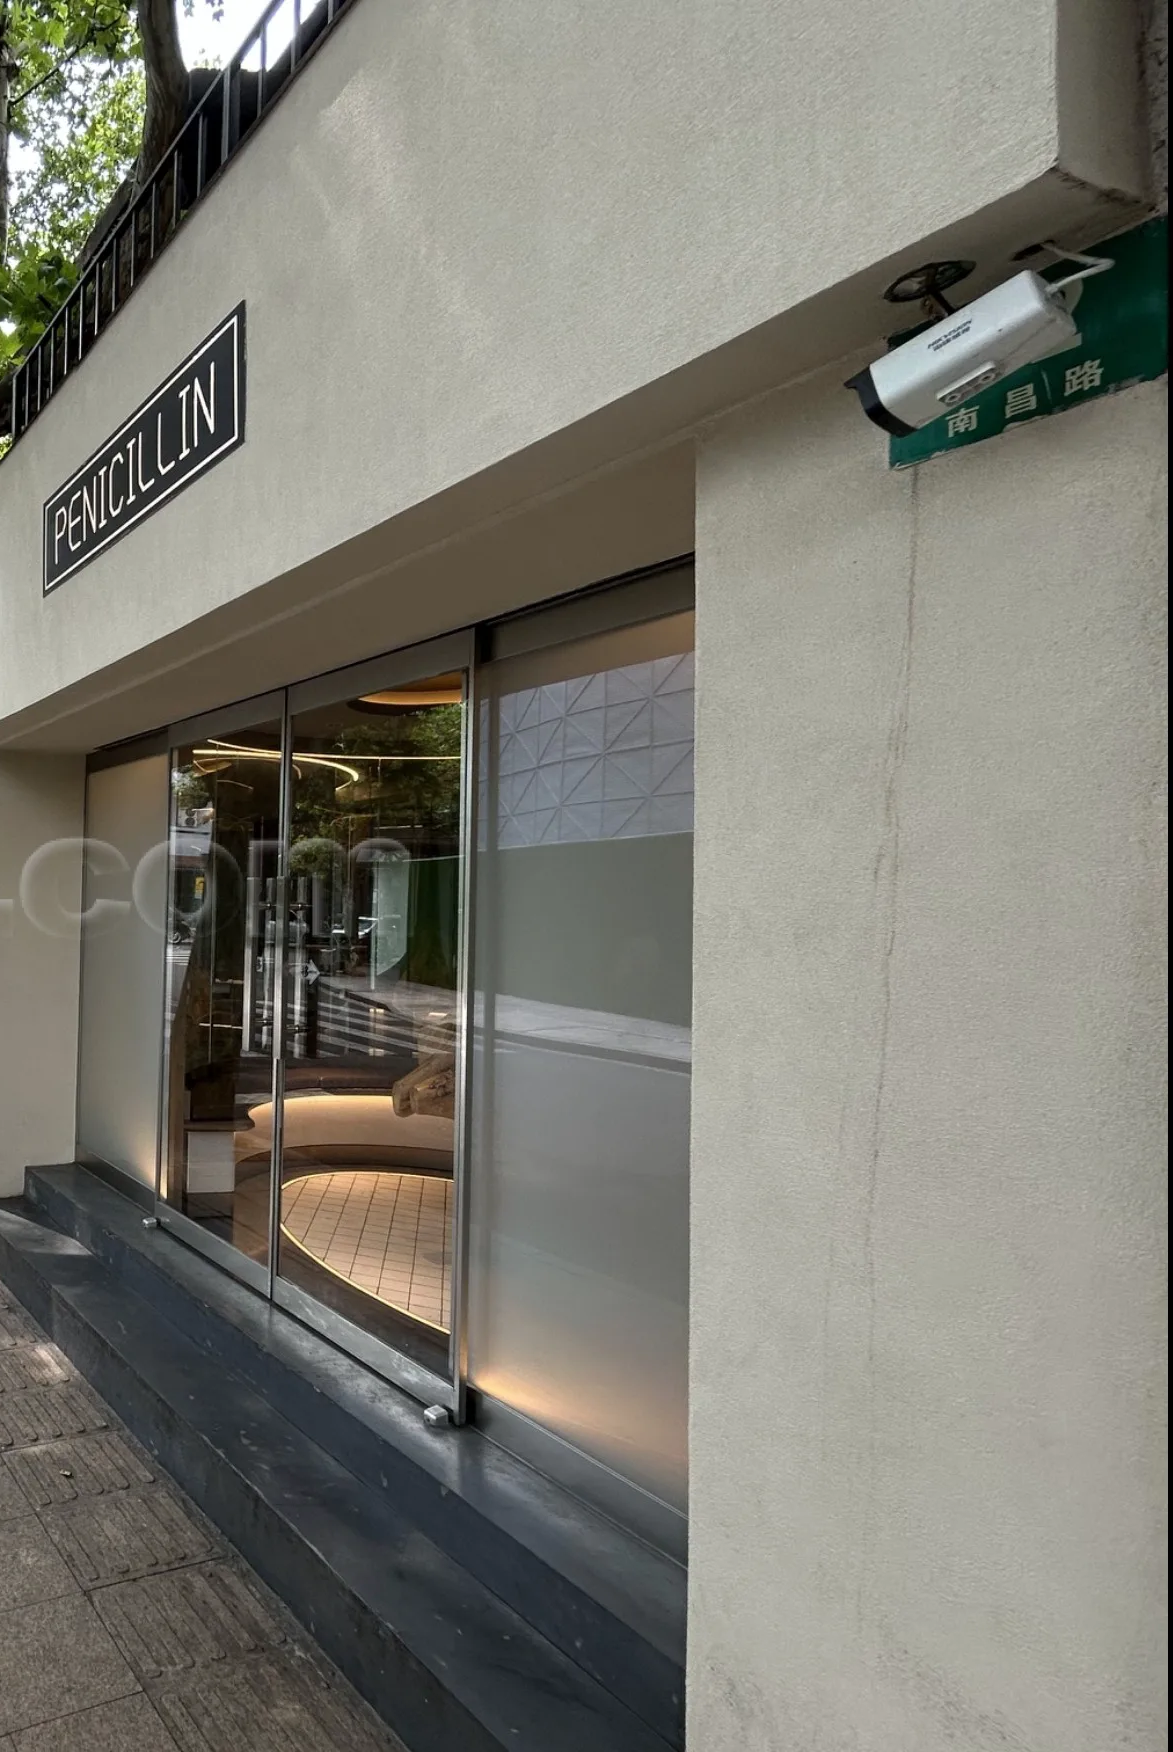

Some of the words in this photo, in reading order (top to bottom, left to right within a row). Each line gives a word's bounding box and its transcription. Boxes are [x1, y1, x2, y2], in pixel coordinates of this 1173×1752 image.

[54, 361, 216, 565] PENICILLIN
[945, 358, 1104, 438] 南昌路
